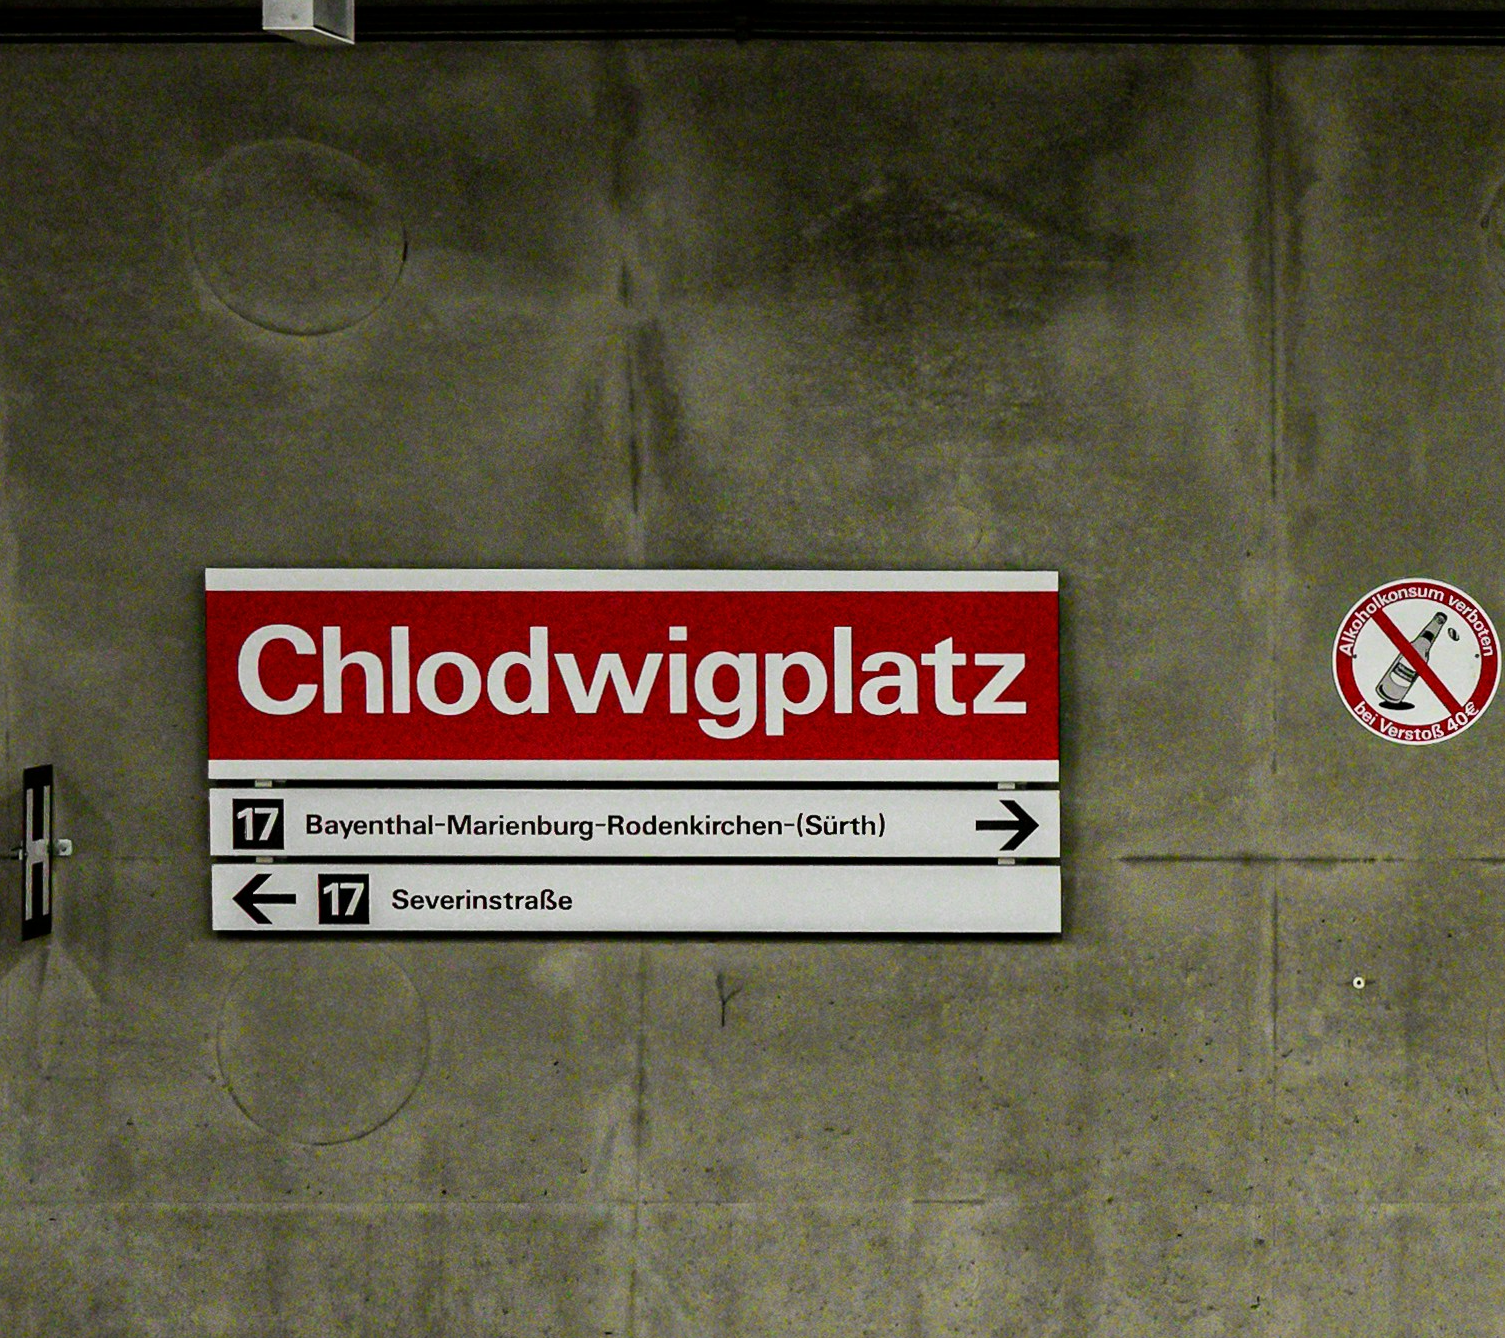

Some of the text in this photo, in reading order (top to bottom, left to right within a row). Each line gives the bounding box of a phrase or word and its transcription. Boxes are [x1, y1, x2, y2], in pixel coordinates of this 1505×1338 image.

[1339, 586, 1493, 657] Alkoholkonsum verboten
[237, 624, 1027, 738] Chlodwigplatz
[1354, 701, 1479, 740] bei Verstoß 40€
[237, 807, 886, 841] 17 Bayenthal-Marienburg-Rodenkirchen-(Sürth)
[323, 881, 573, 916] 17 Severinstraße
